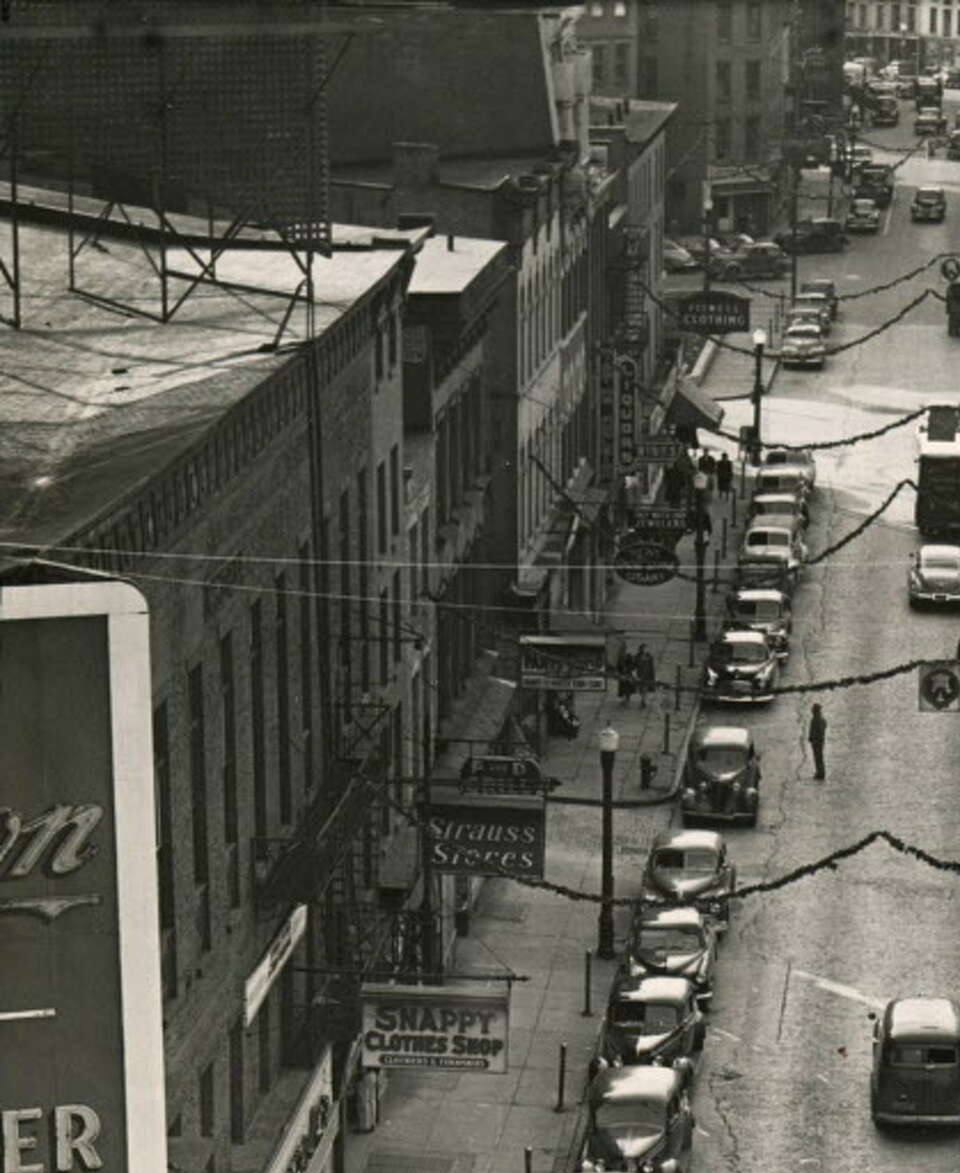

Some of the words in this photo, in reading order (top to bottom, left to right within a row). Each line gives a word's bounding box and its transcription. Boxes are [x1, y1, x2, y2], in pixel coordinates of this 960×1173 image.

[683, 314, 745, 325] CLOTHING
[430, 819, 536, 844] Strauss
[431, 843, 533, 868] Stores
[375, 1005, 495, 1034] SNAPPY
[365, 1031, 449, 1053] CLOTHES
[451, 1035, 504, 1056] SHOP
